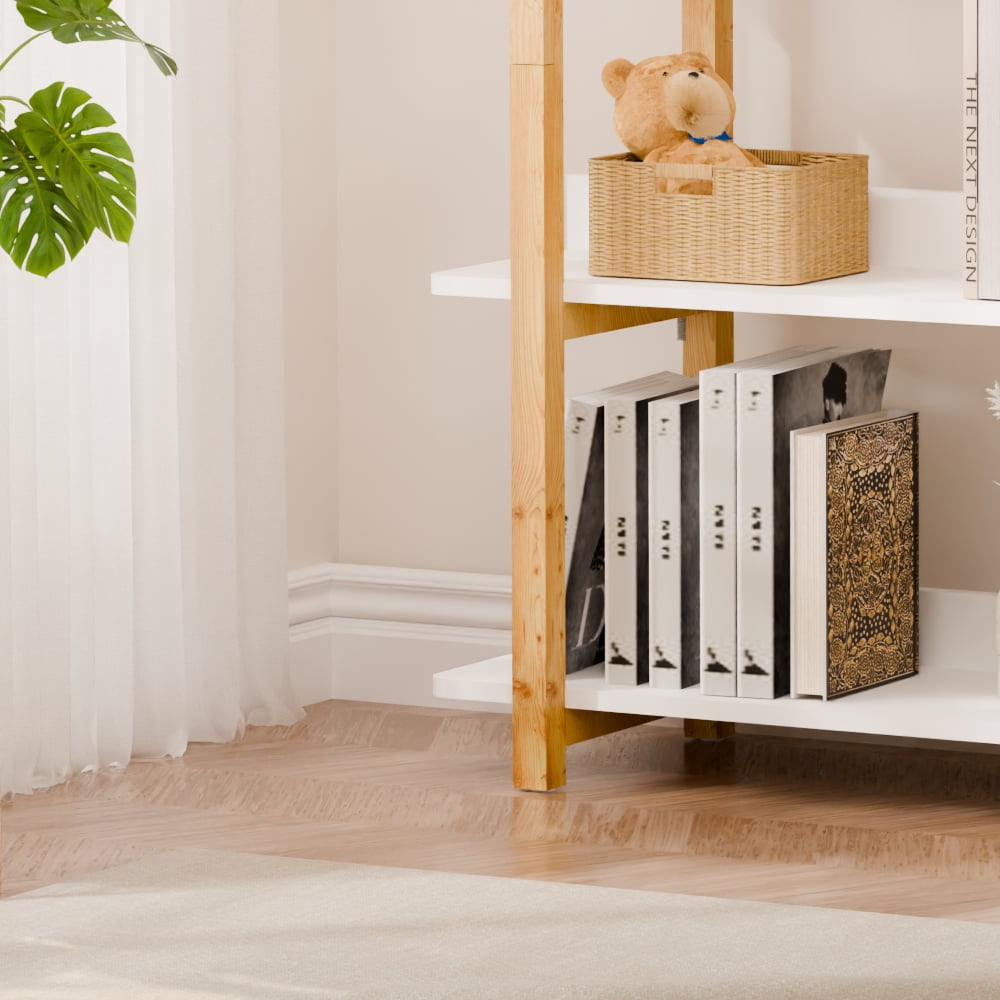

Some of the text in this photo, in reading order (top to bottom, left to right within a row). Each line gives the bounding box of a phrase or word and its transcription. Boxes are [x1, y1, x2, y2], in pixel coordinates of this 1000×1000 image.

[965, 72, 978, 283] THE NEXT DESIGN
